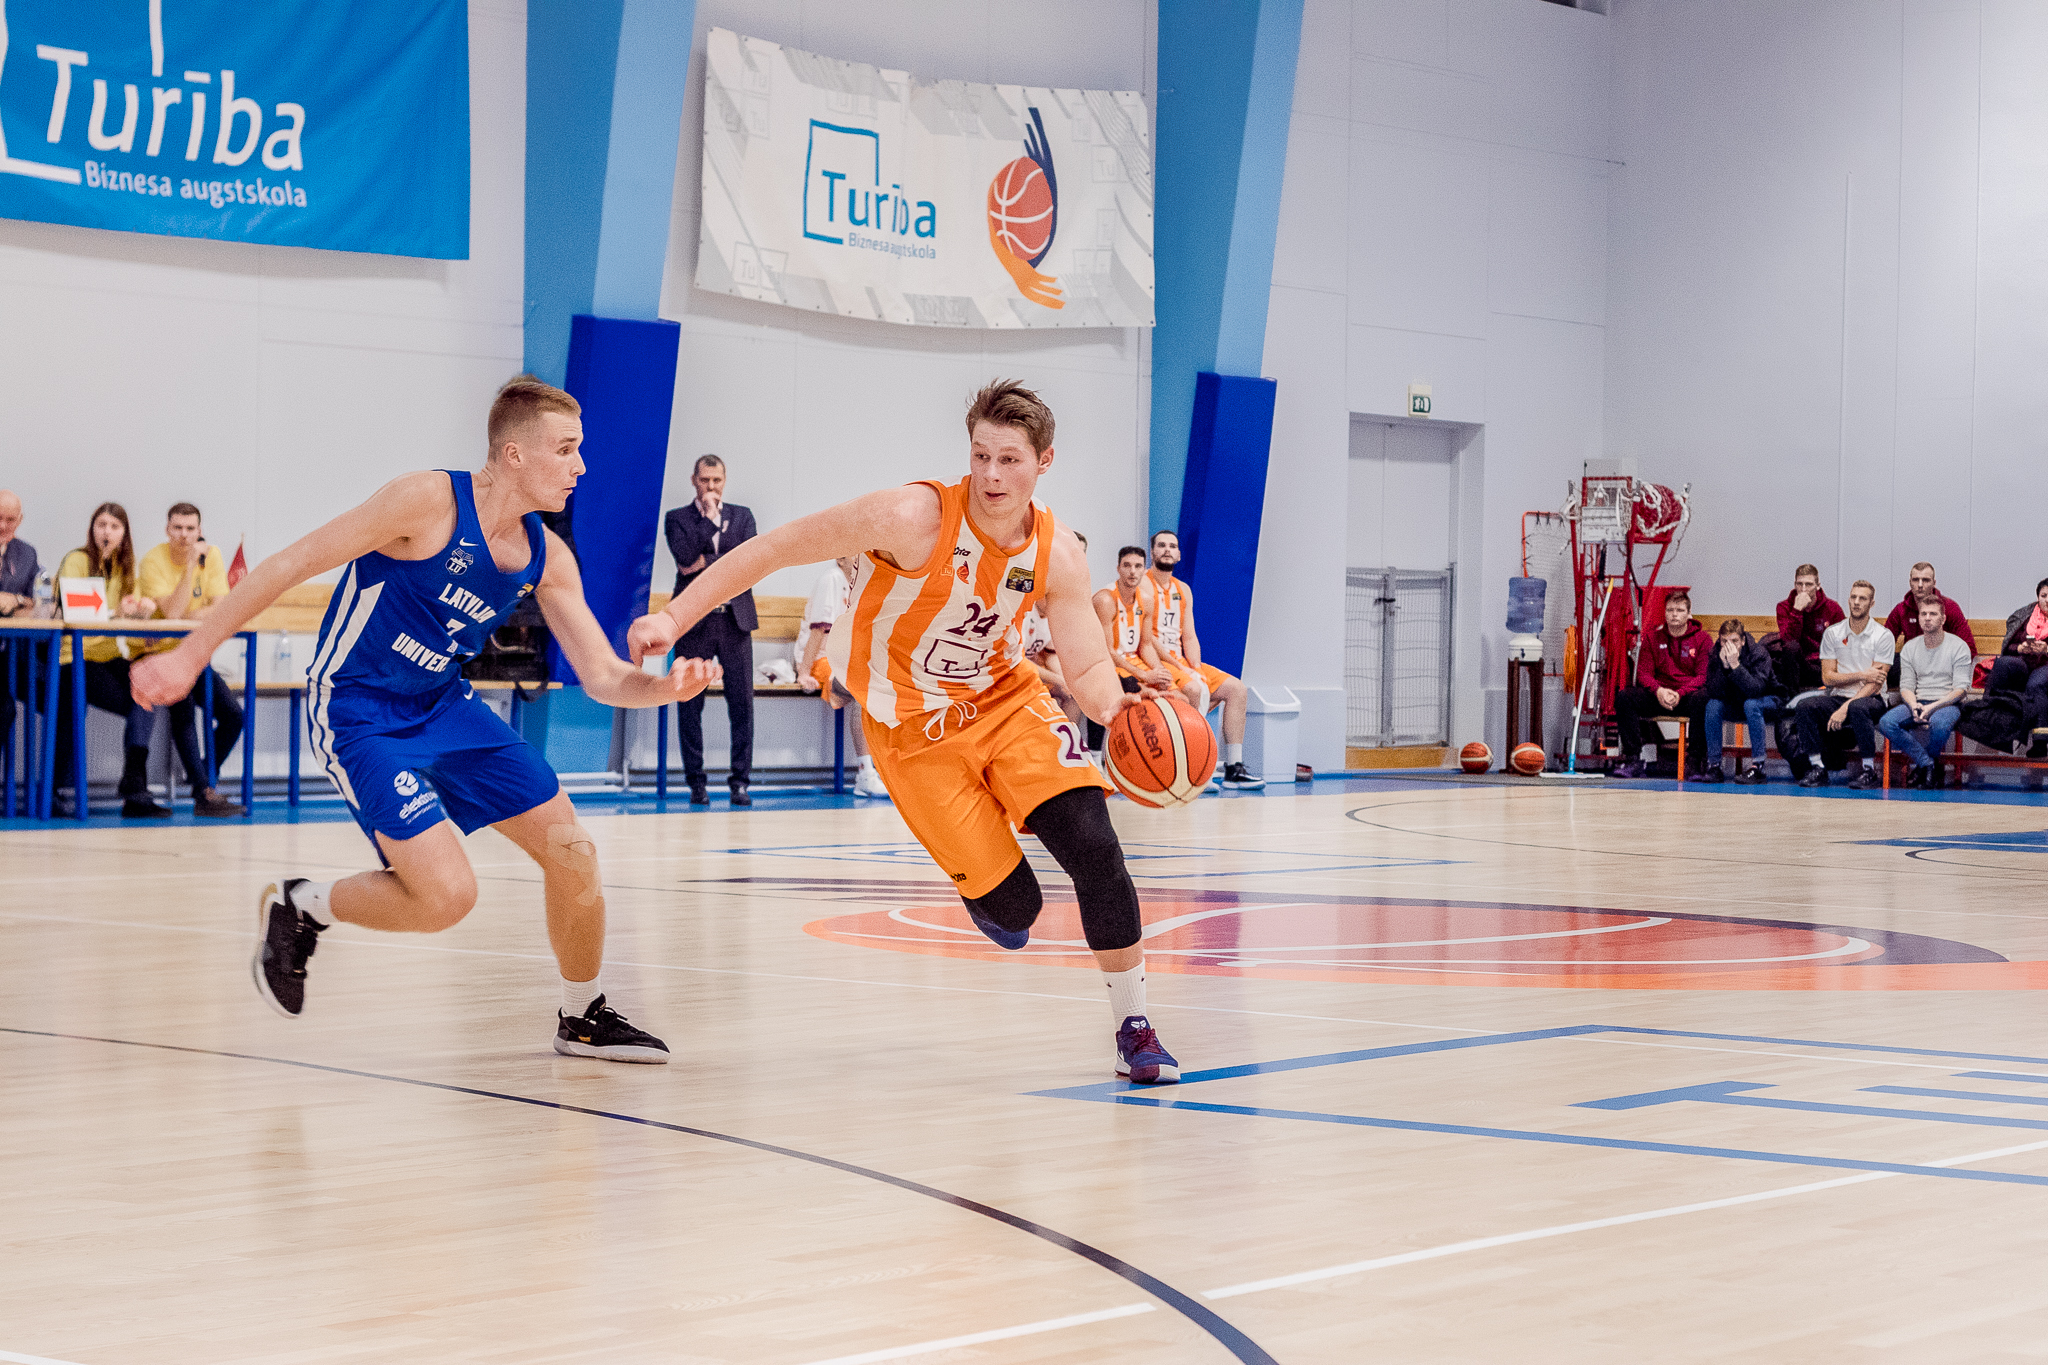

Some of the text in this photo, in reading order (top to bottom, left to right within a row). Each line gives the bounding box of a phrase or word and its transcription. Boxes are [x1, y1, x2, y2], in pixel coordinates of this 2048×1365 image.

[36, 44, 305, 171] Turība
[84, 159, 308, 209] Biznesa augstskola
[848, 231, 890, 253] Biznesa
[945, 602, 1000, 638] 24
[1127, 629, 1136, 646] 3
